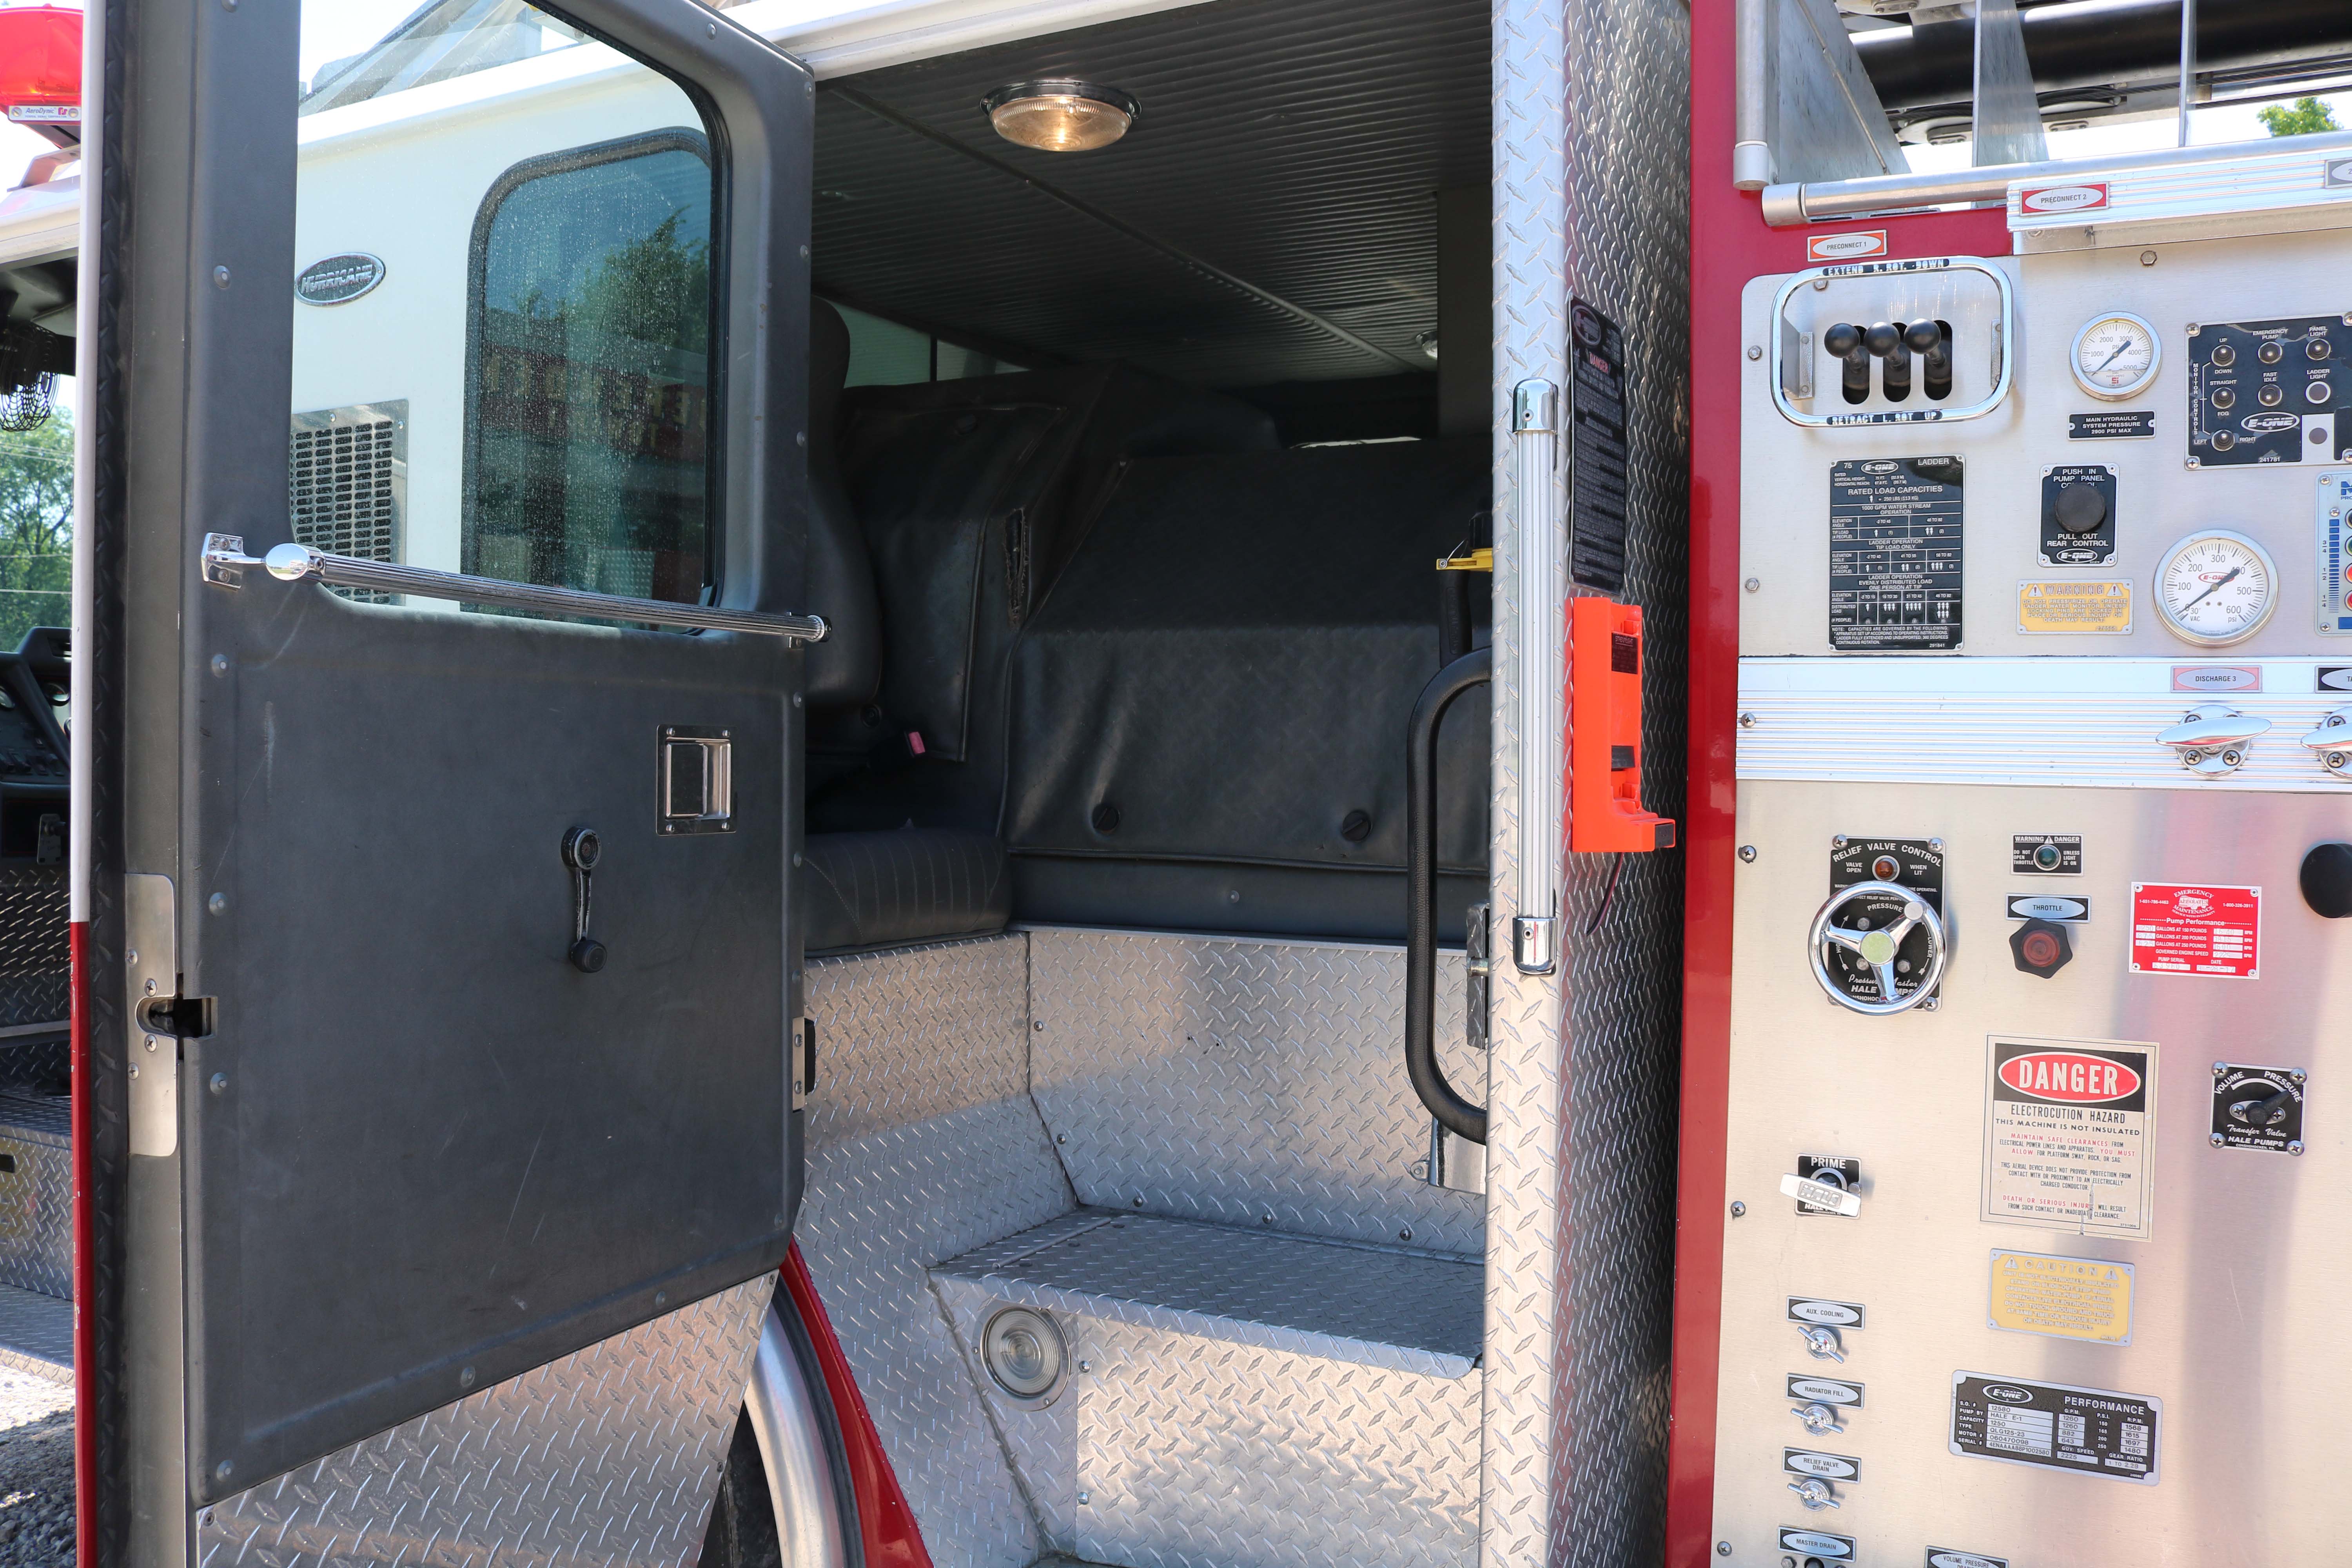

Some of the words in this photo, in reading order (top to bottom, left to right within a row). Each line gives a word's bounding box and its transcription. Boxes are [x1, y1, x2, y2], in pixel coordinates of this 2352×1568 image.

[2041, 195, 2081, 203] PRECONNECT
[1827, 242, 1862, 250] PRECONNECT
[1828, 265, 1864, 275] EXTEND
[1886, 262, 1907, 270] ROT.
[1916, 259, 1944, 269] DOWN
[1832, 415, 1874, 425] RETRACT
[1895, 413, 1913, 421] ROT
[1924, 412, 1937, 420] UP
[2248, 417, 2294, 427] E-ONE
[2211, 555, 2225, 563] 300
[2045, 585, 2104, 595] WARNING
[2226, 606, 2241, 614] 600
[1832, 846, 1862, 862] RELIEF
[1901, 844, 1942, 867] CONTROL
[2174, 889, 2214, 898] EMERGENCY
[1867, 903, 1904, 912] PRESSURE
[2173, 905, 2214, 914] MAINTENANCE
[1851, 985, 1878, 993] HALE
[2019, 1060, 2118, 1095] DANGER
[2214, 1071, 2244, 1095] VOLUME
[2264, 1071, 2303, 1103] PRESSURE
[2011, 1104, 2083, 1121] ELECTROCUTION
[2090, 1111, 2125, 1124] HAZARD
[2017, 1120, 2056, 1129] MACHINE
[2092, 1126, 2140, 1136] INSULATED
[2227, 1124, 2260, 1136] Transfer
[2265, 1128, 2287, 1137] Valve
[2011, 1133, 2043, 1142] MAINTAIN
[2067, 1138, 2108, 1147] CLEARANCES
[2254, 1138, 2284, 1147] PUMPS
[1811, 1157, 1846, 1169] PRIME
[2025, 1260, 2097, 1276] CAUTION
[1804, 1386, 1831, 1395] RADIATOR
[1993, 1388, 2022, 1399] E-ONE
[2064, 1396, 2145, 1416] PERFORMANCE
[1803, 1457, 1822, 1466] RELIEF
[1823, 1460, 1839, 1468] VALVE
[1796, 1538, 1818, 1547] MASTER
[1819, 1542, 1837, 1550] DRAIN
[1943, 1555, 1962, 1564] VOLUME
[1965, 1559, 1989, 1568] PRESSURE
